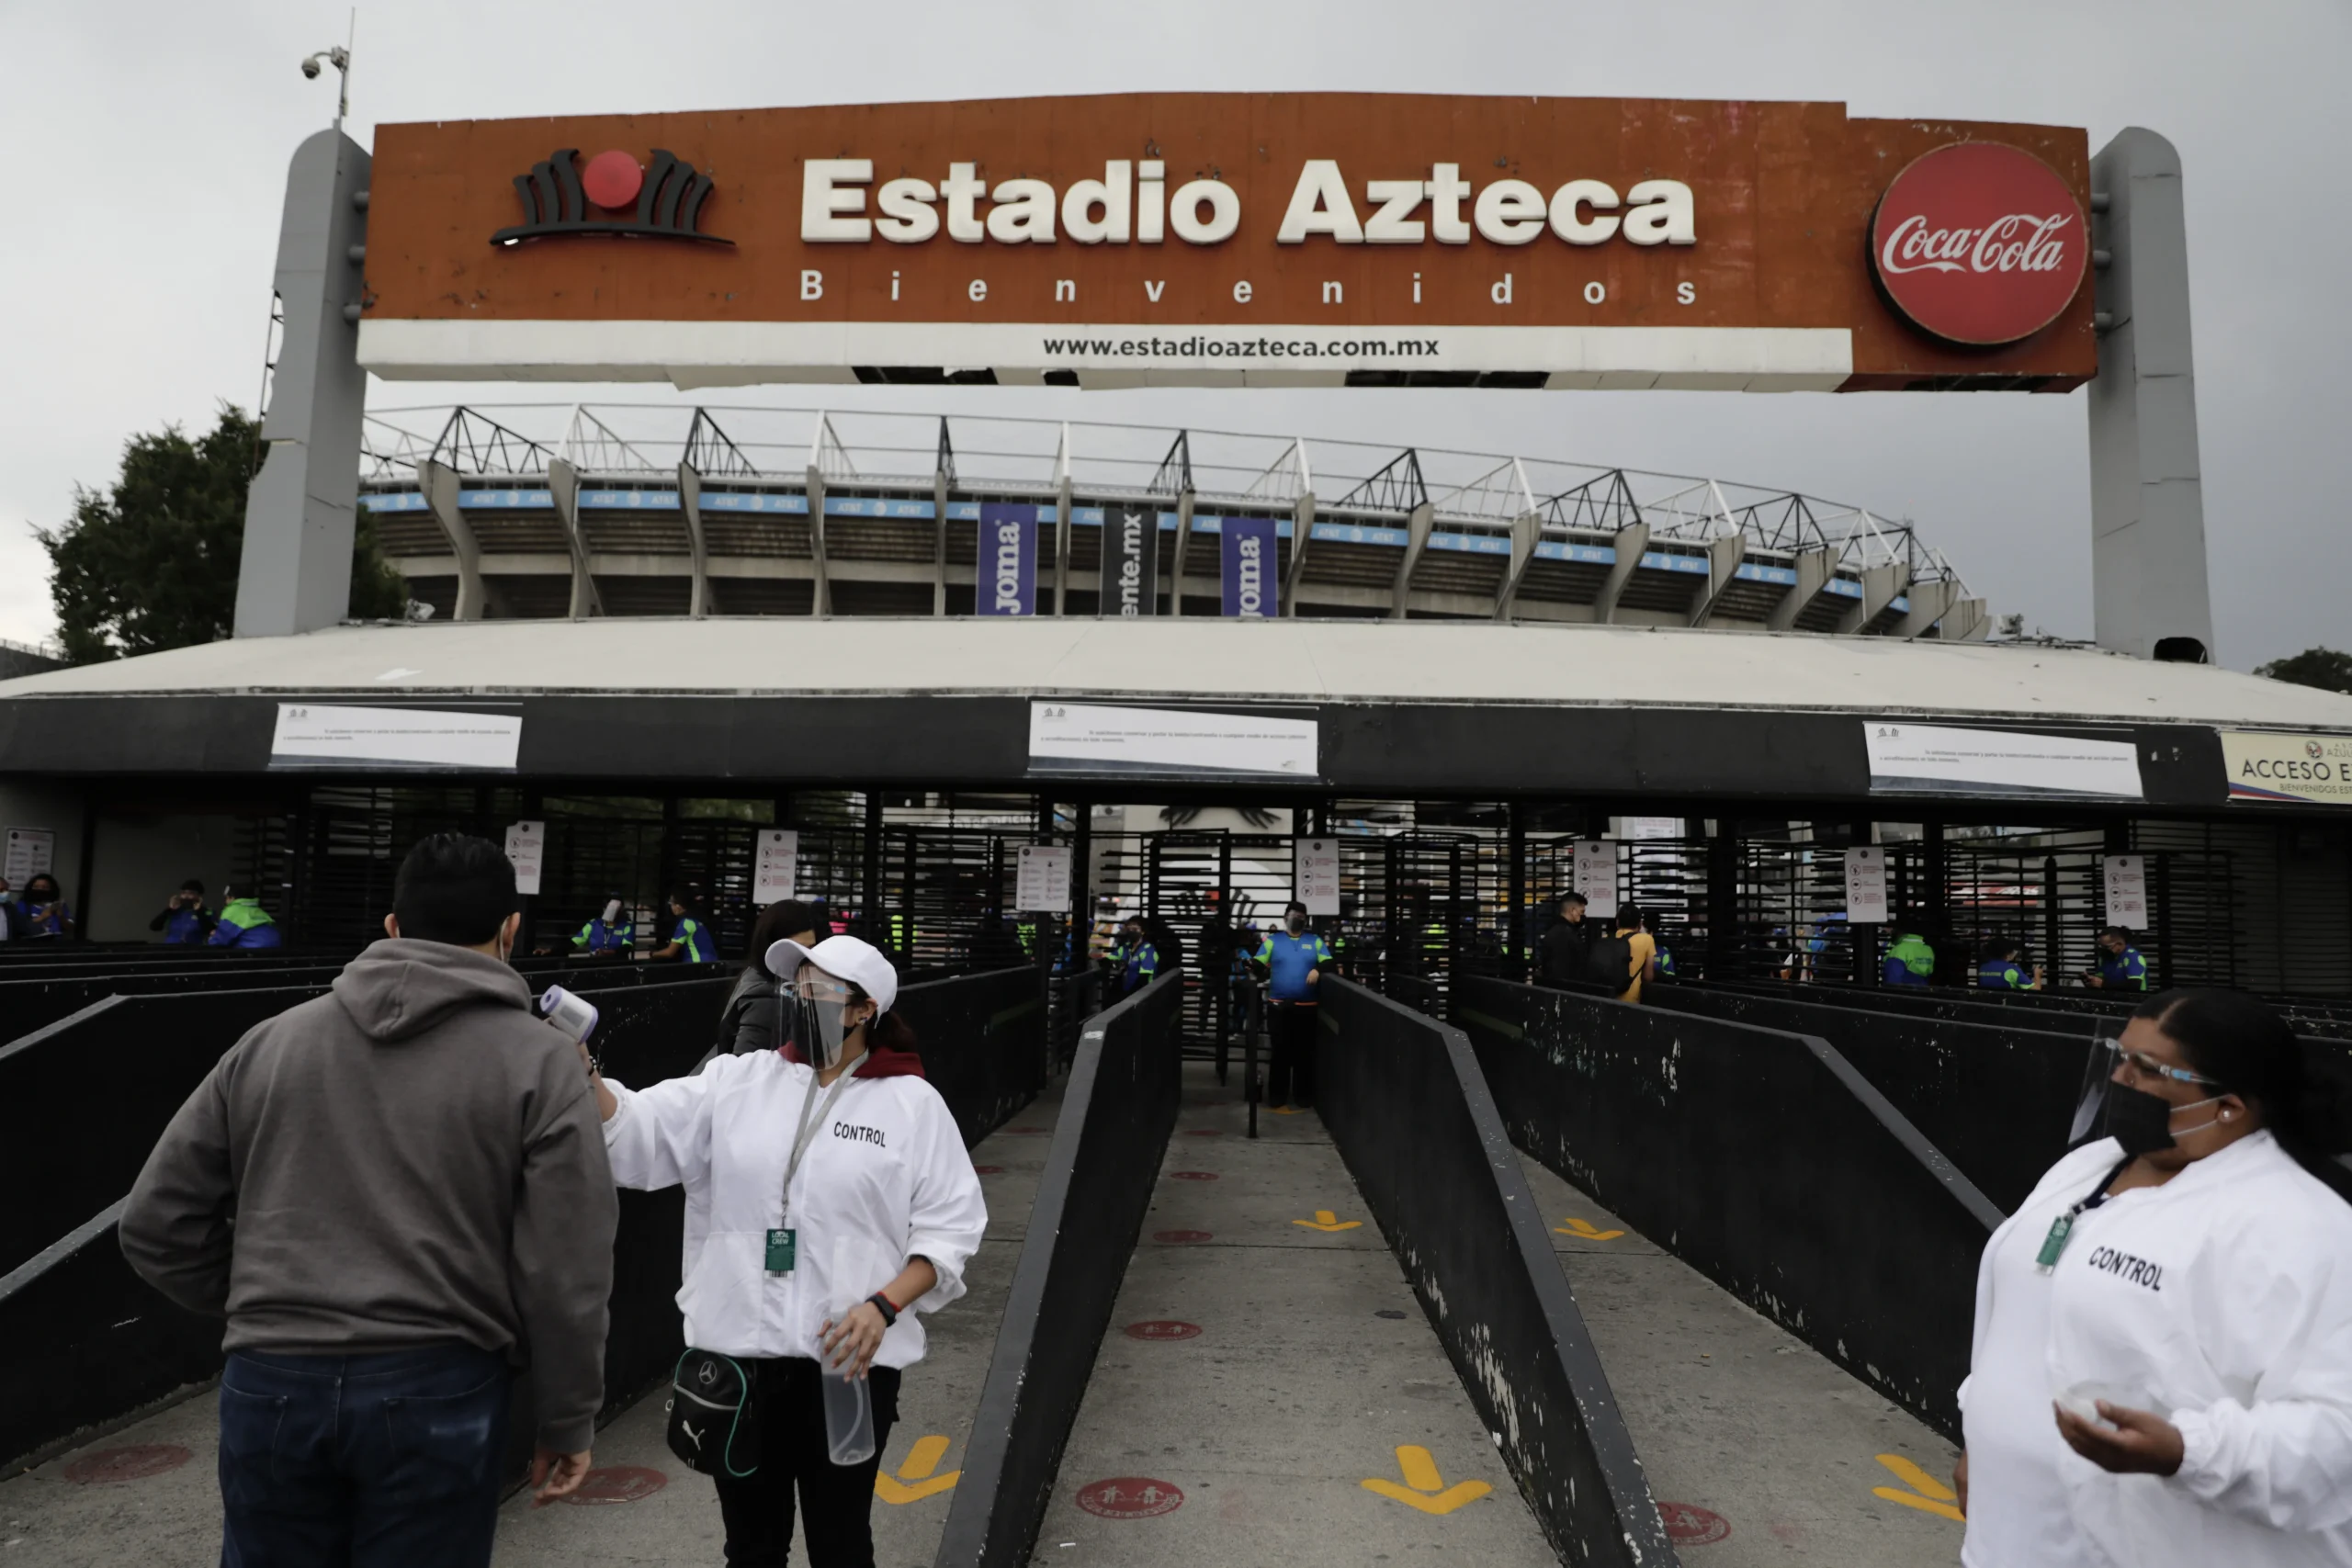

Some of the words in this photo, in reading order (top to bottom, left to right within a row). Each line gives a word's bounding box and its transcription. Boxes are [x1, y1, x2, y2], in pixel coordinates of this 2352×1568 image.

[800, 158, 1241, 244] Estadio
[1276, 159, 1697, 245] Azteca
[1882, 212, 2074, 274] Coca-Cola
[1044, 335, 1440, 357] www.estadioazteca.com.mx
[2242, 758, 2331, 781] ACCESO
[2339, 762, 2352, 782] E
[2279, 783, 2337, 795] BIENVENIDOS
[833, 1122, 887, 1147] CONTROL
[2089, 1247, 2163, 1292] CONTROL
